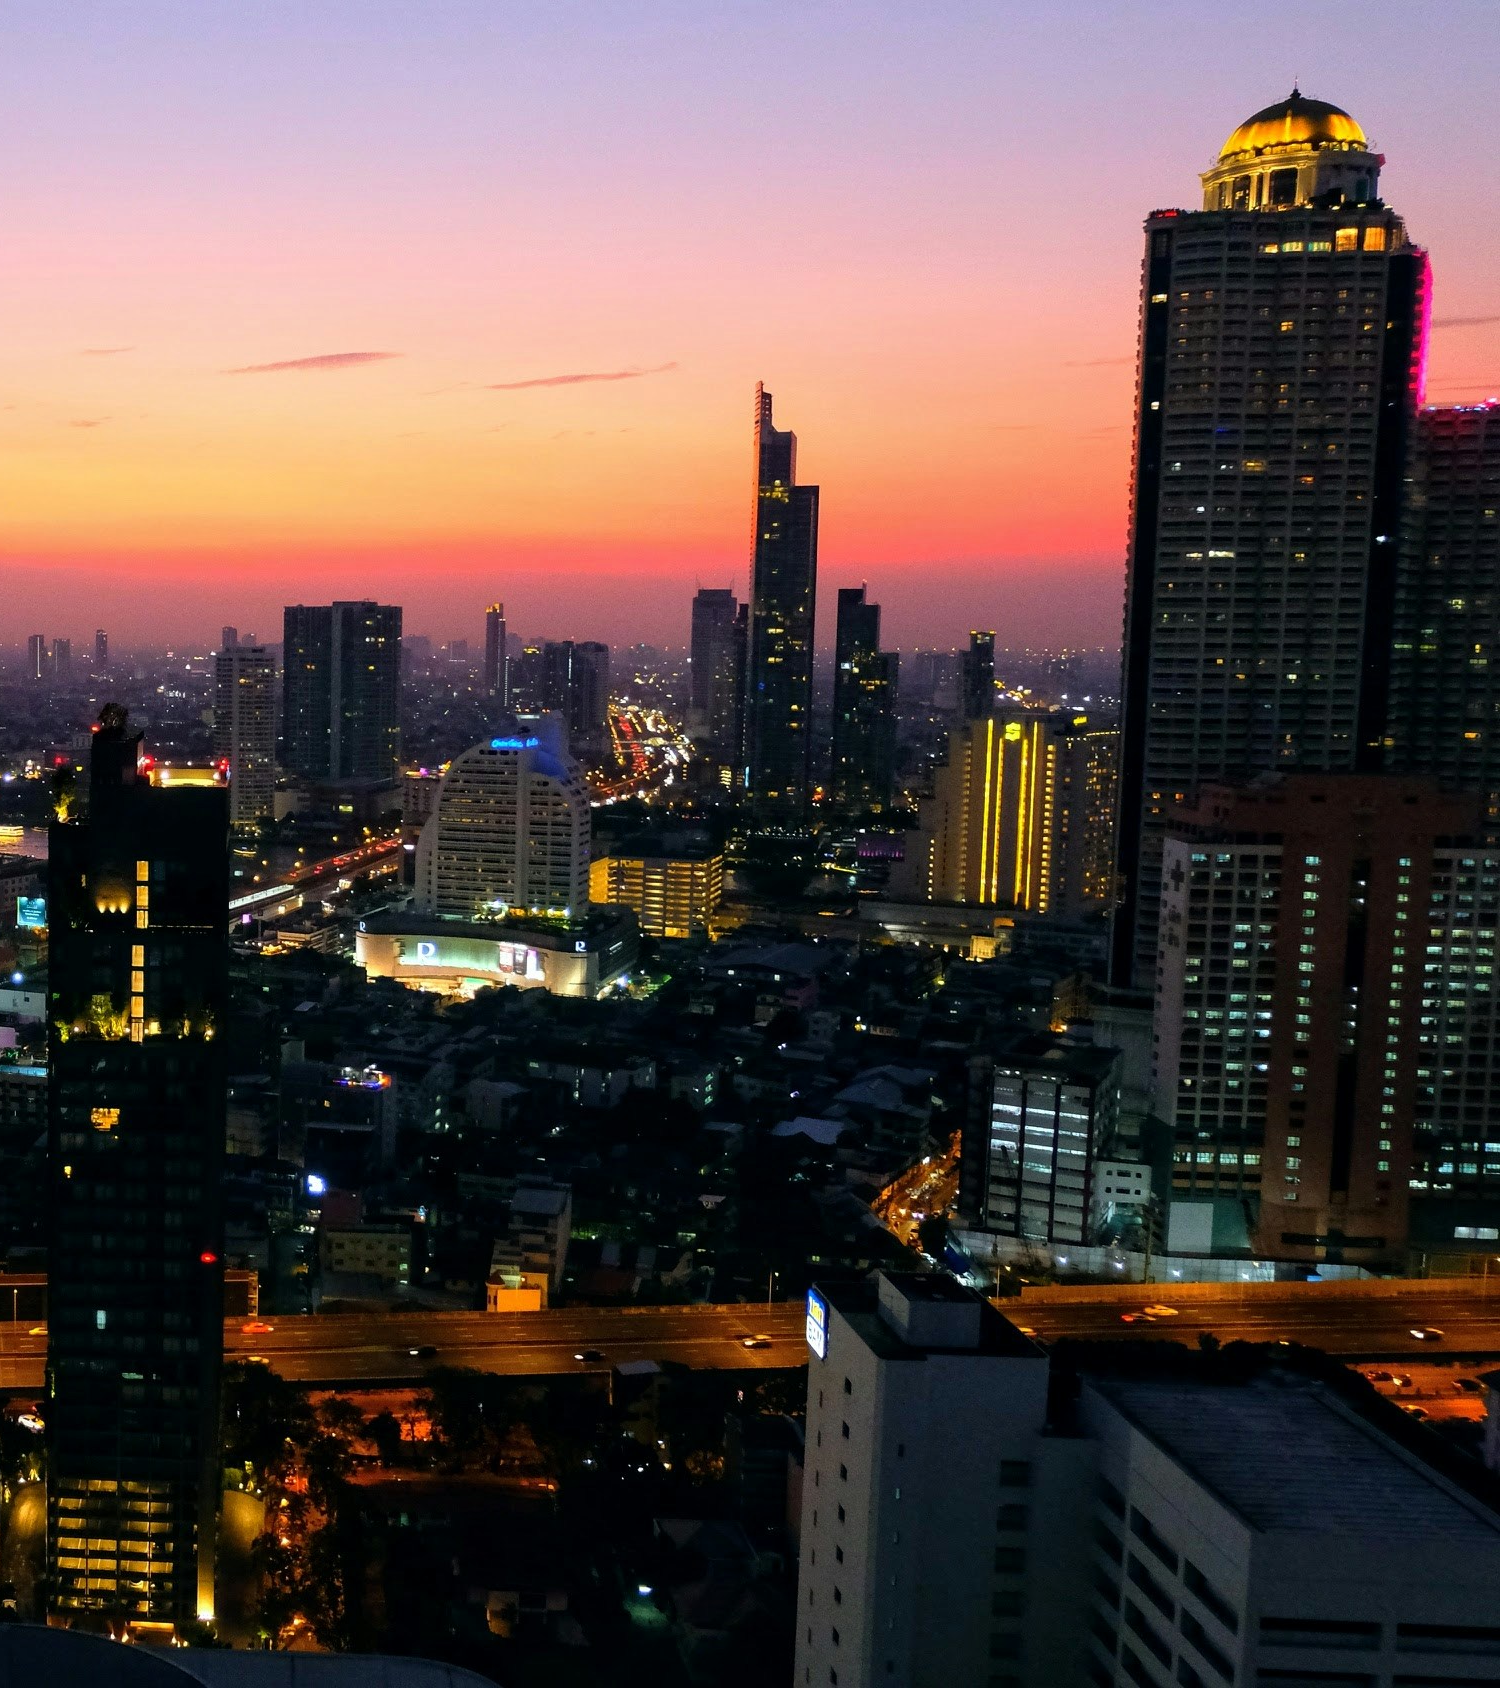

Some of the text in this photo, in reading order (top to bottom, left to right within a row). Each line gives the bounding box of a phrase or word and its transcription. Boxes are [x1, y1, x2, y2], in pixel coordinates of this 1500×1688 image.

[360, 921, 366, 932] R
[575, 940, 587, 952] R
[417, 942, 437, 964] R
